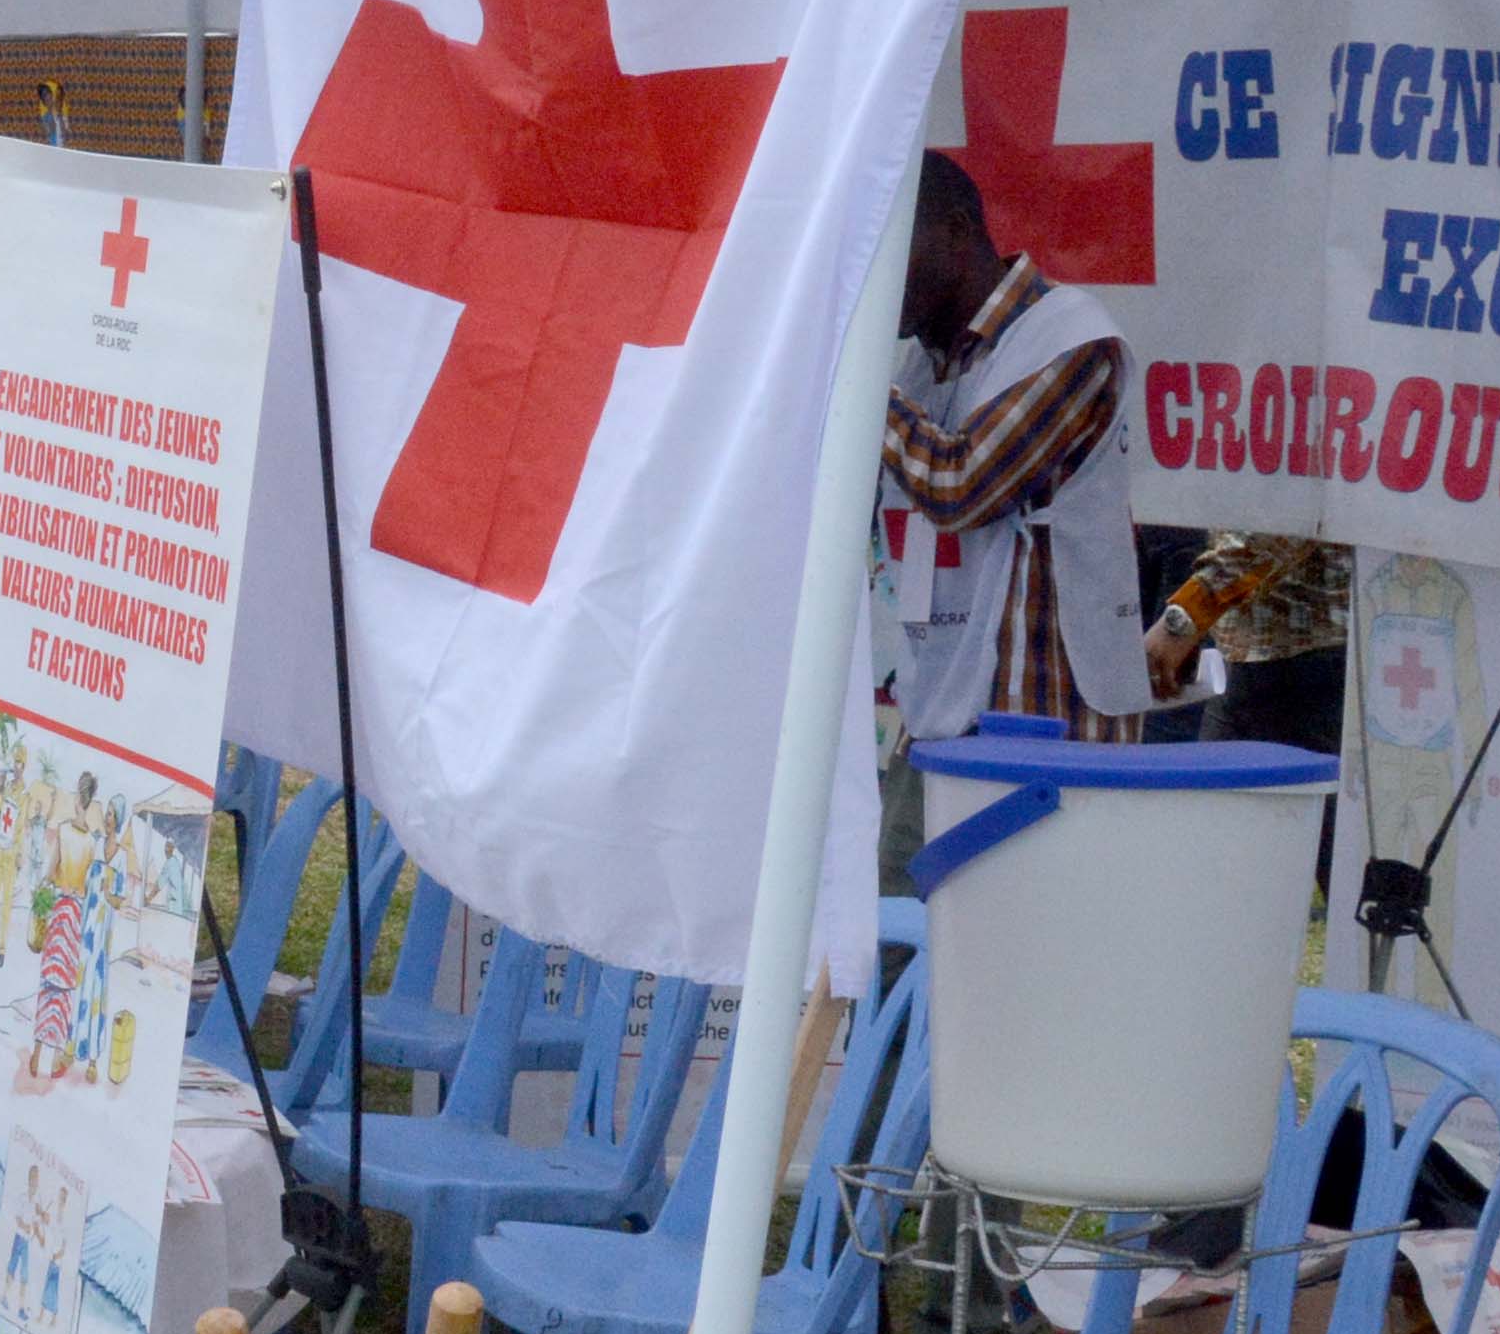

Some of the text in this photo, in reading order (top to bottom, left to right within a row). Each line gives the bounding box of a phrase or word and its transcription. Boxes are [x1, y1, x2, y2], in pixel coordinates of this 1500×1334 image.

[1173, 48, 1280, 162] CE
[119, 397, 154, 447] DES
[156, 411, 221, 466] JEUNES
[3, 433, 113, 503] VOLONTAIRES
[124, 467, 220, 539] DIFFUSION,
[0, 556, 72, 618] VALEURS
[75, 578, 208, 666] HUMANITAIRES
[100, 525, 121, 568] ET
[124, 530, 230, 605] PROMOTION
[27, 627, 126, 702] ET ACTIONS
